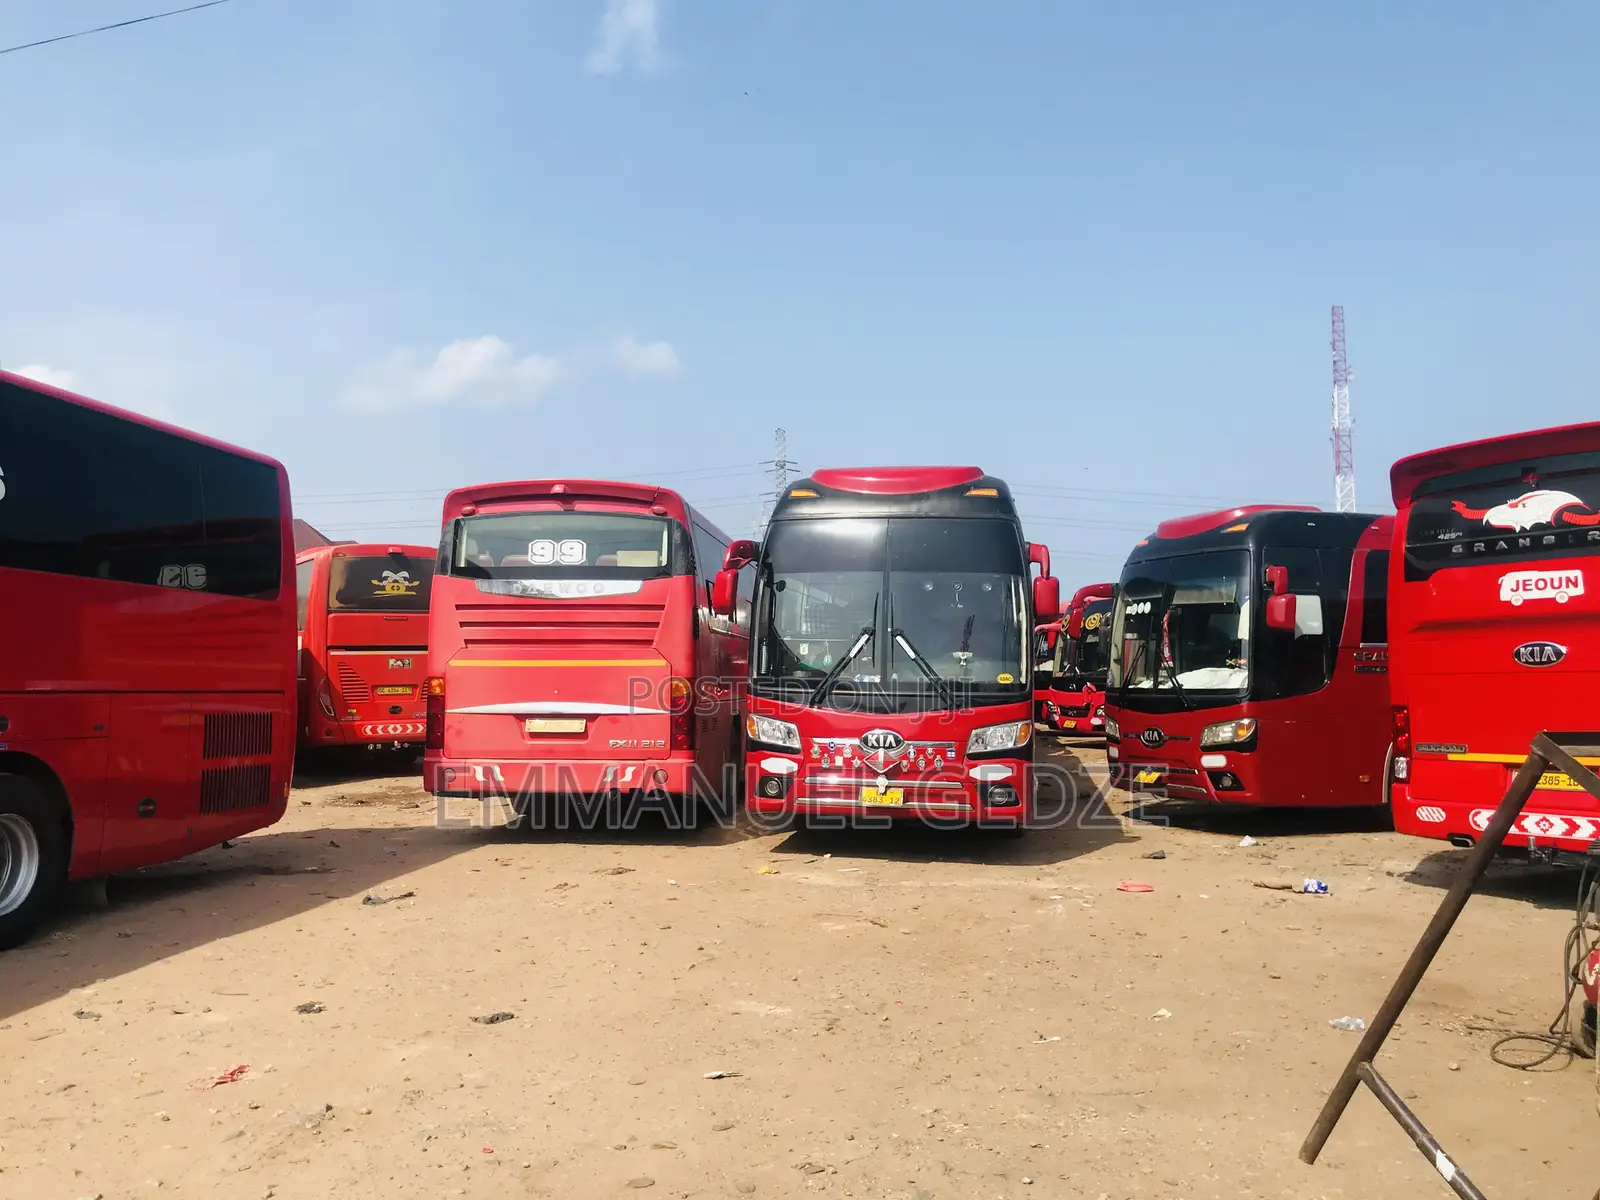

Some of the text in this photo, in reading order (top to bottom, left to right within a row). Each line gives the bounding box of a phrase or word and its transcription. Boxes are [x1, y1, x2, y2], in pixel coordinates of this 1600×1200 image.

[528, 539, 587, 565] 99
[512, 583, 605, 596] DAEWOO
[1510, 575, 1579, 593] JEOUN
[1519, 646, 1557, 663] KIA
[867, 734, 897, 747] KIA
[1143, 730, 1160, 741] KIA
[641, 739, 666, 748] 212
